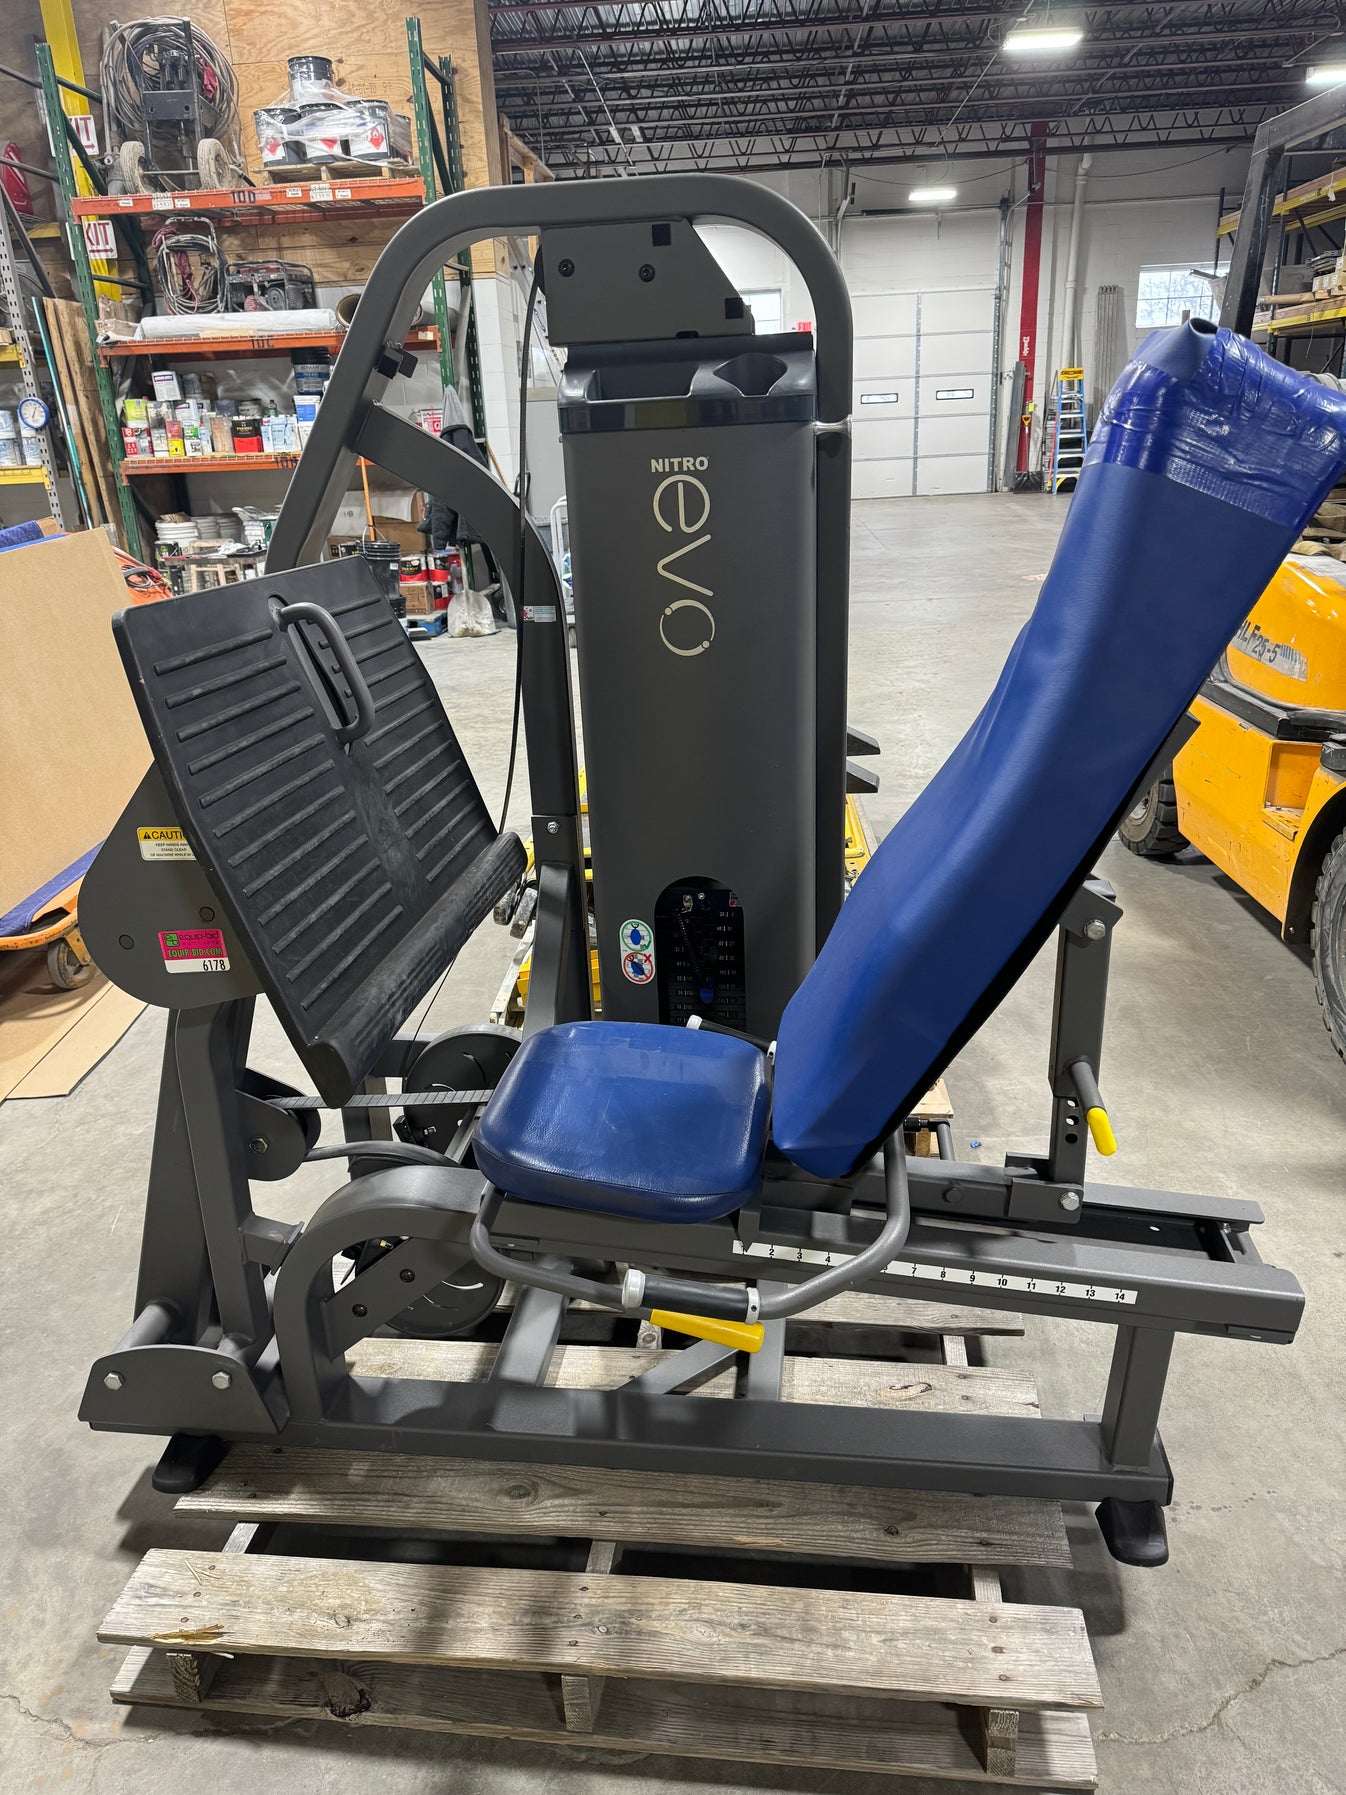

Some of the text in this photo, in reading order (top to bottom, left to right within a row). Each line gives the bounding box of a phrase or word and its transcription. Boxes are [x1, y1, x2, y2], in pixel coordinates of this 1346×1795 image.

[650, 456, 709, 473] NITRO
[151, 830, 187, 841] CAUTI
[202, 959, 226, 971] 6178
[768, 1248, 775, 1256] 2
[796, 1252, 803, 1260] 3
[825, 1255, 831, 1263] 4
[940, 1270, 946, 1278] 8
[969, 1274, 976, 1282] 9
[997, 1278, 1008, 1287] 10
[1026, 1282, 1037, 1290] 11
[1055, 1285, 1067, 1294] 12
[1085, 1289, 1096, 1297] 13
[1114, 1292, 1125, 1301] 14
